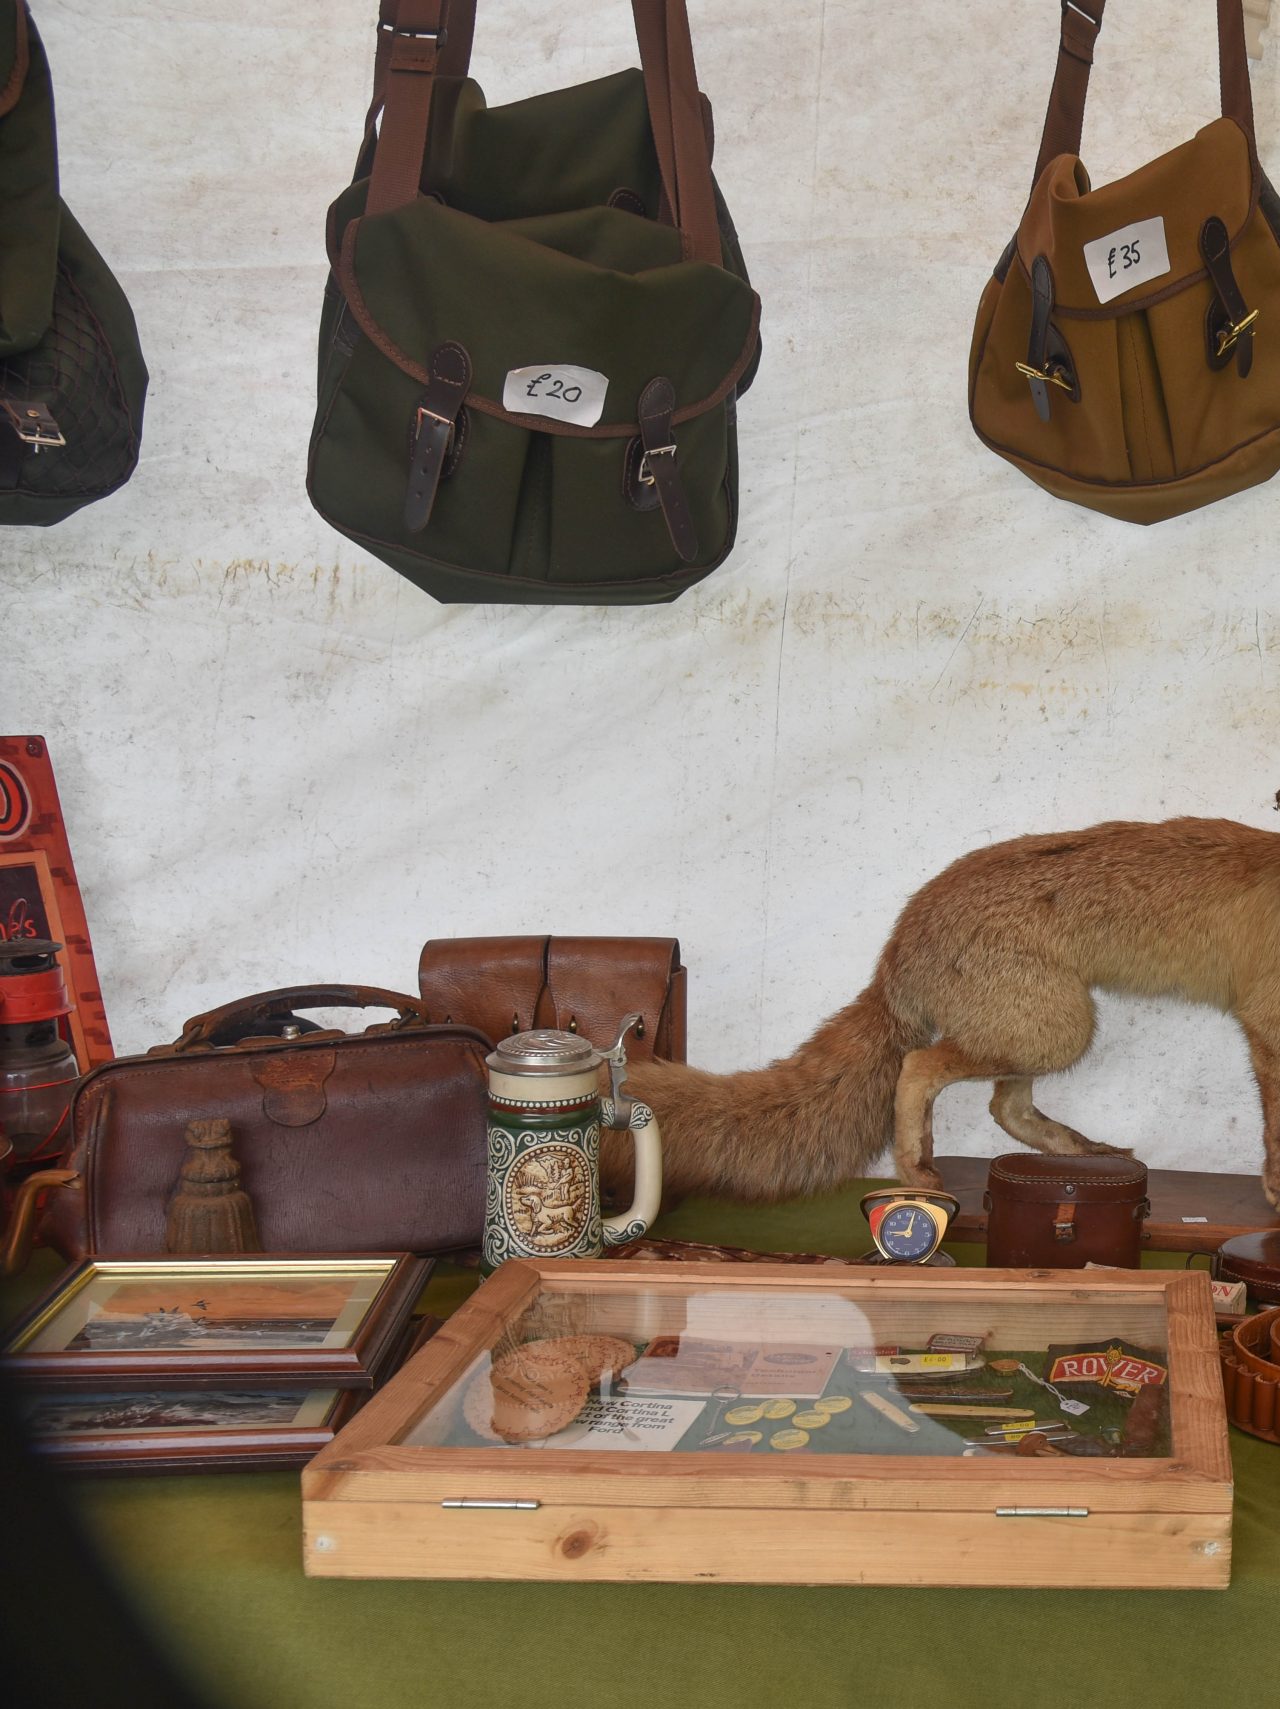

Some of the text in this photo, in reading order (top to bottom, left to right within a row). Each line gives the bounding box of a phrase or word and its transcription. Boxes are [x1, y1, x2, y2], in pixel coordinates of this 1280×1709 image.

[1107, 239, 1141, 279] £35
[526, 373, 582, 402] £20
[1061, 1357, 1158, 1384] ROVER
[620, 1400, 673, 1410] Cortina
[605, 1406, 659, 1416] Cortina
[588, 1419, 628, 1429] range
[631, 1421, 666, 1430] from
[636, 1416, 675, 1424] great
[588, 1426, 625, 1434] Ford
